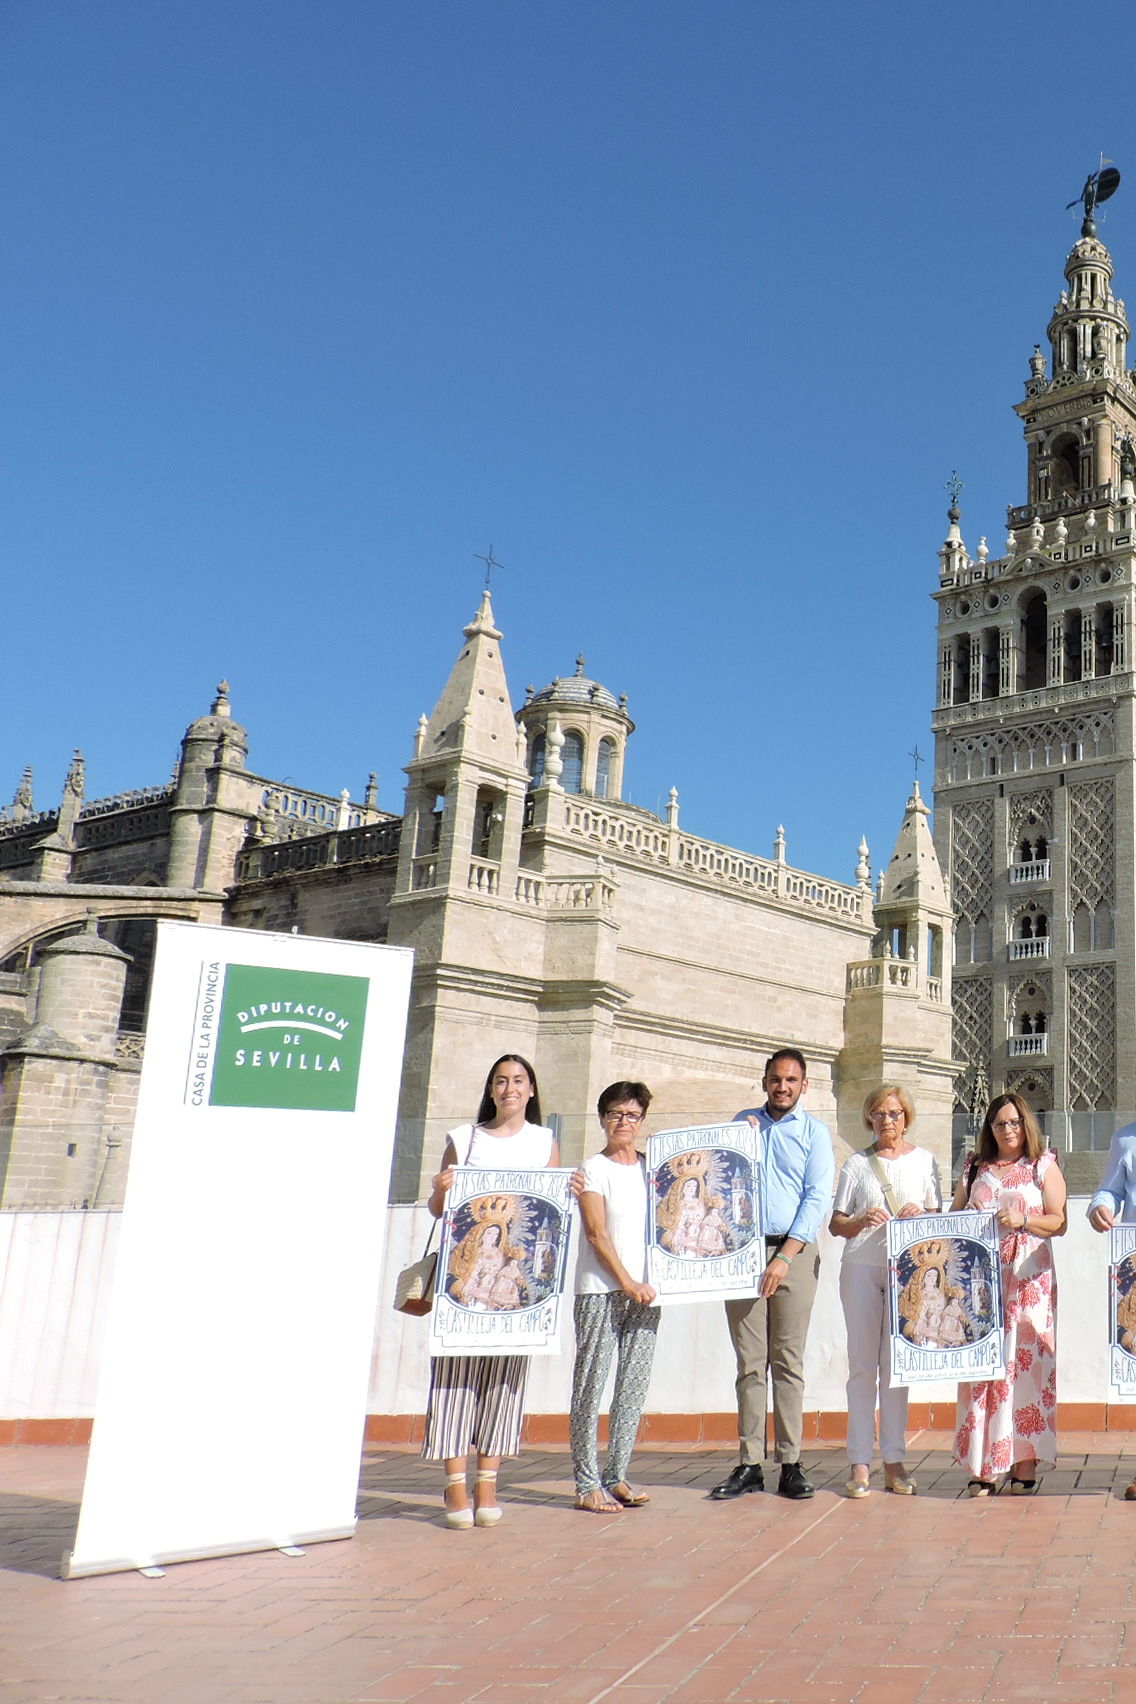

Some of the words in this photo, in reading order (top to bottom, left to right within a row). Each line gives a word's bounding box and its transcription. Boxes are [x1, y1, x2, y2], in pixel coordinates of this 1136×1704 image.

[202, 962, 220, 1029] PROVINCIA
[236, 1001, 349, 1032] DIPUTACION
[200, 1033, 210, 1048] LA
[284, 1034, 299, 1045] DE
[197, 1052, 208, 1068] DE
[235, 1050, 340, 1072] SEVILLA
[192, 1072, 205, 1106] CASA
[494, 1173, 545, 1193] PATRONALES
[894, 1220, 924, 1251] FIESTAS
[927, 1217, 970, 1234] PATRONALES
[904, 1347, 948, 1371] CASTILLEJA
[951, 1352, 964, 1368] DEL
[968, 1341, 991, 1367] CAMPO
